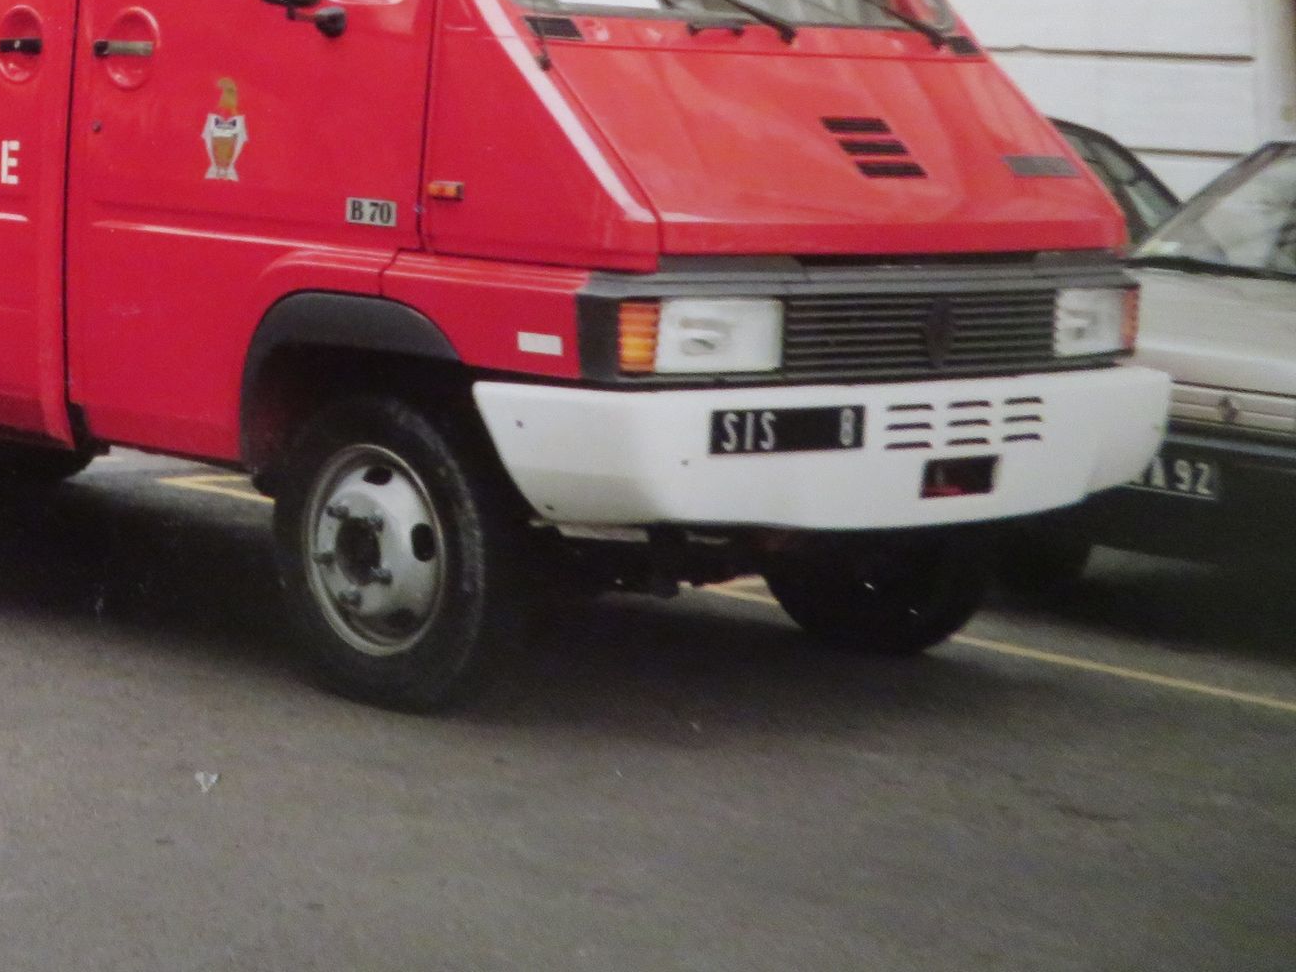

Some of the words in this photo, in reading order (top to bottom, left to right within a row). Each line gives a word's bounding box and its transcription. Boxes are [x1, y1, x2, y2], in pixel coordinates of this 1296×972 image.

[350, 199, 364, 220] B
[369, 202, 393, 224] 70
[721, 411, 777, 453] SIS
